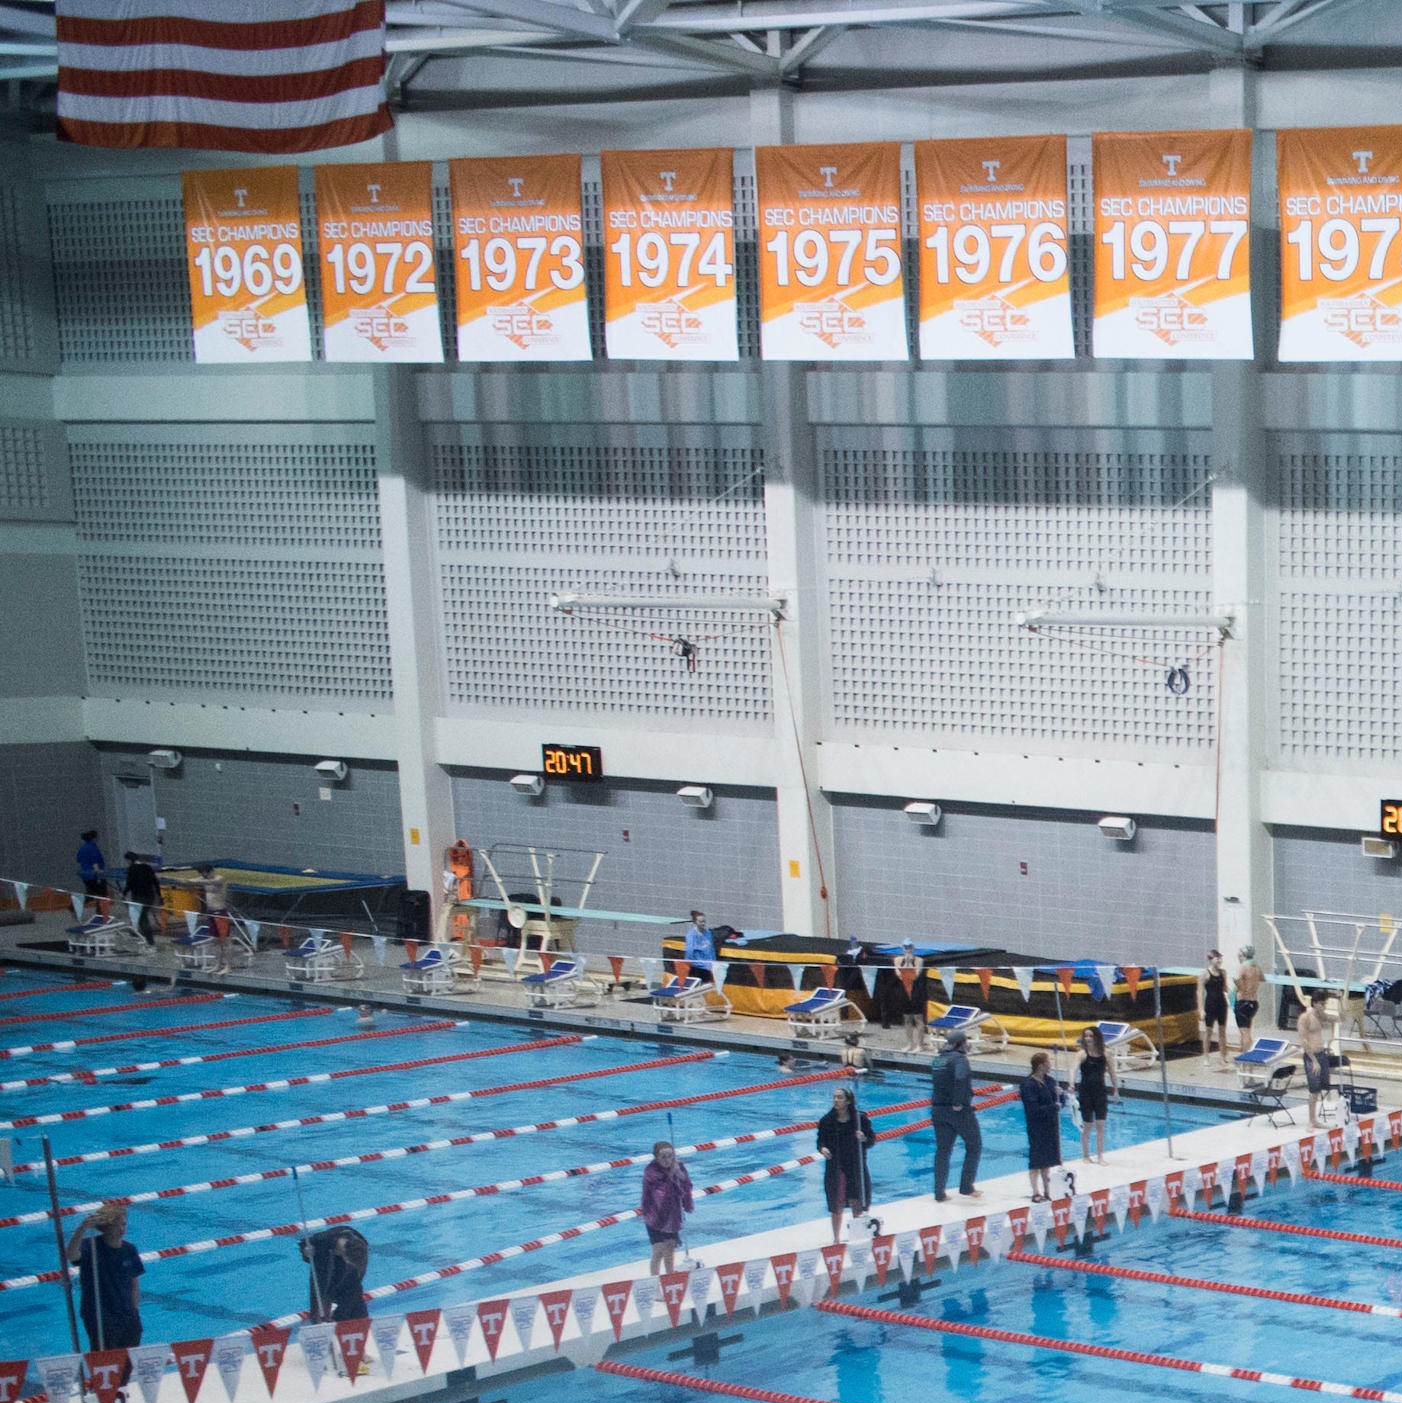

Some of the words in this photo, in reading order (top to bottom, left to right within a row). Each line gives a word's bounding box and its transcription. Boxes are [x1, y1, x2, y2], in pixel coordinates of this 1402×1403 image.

[982, 160, 1000, 182] T
[1162, 154, 1181, 176] T
[1352, 150, 1373, 173] T
[508, 178, 524, 197] T
[660, 172, 676, 191] T
[820, 166, 837, 187] T
[234, 188, 248, 207] T
[367, 184, 381, 203] T
[765, 207, 794, 226] SEC
[799, 206, 898, 225] CHAMPIONS
[923, 203, 955, 223] SEC
[960, 200, 1065, 220] CHAMPIONS
[1100, 198, 1133, 217] SEC
[1138, 196, 1247, 216] CHAMPIONS
[1286, 197, 1320, 216] SEC
[324, 222, 347, 239] SEC
[351, 220, 432, 238] CHAMPIONS
[459, 217, 485, 235] SEC
[489, 214, 581, 233] CHAMPIONS
[609, 211, 636, 228] SEC
[640, 210, 732, 228] CHAMPIONS
[191, 226, 214, 242] SEC
[218, 222, 298, 240] CHAMPIONS
[611, 231, 733, 287] 1974
[766, 228, 901, 287] 1975
[925, 222, 1068, 284] 1976
[1101, 219, 1249, 281] 1977
[194, 242, 302, 297] 1969
[327, 241, 435, 294] 1972
[460, 235, 585, 291] 1973
[225, 317, 276, 338] SEC
[356, 317, 408, 338] SEC
[494, 315, 553, 335] SEC
[643, 313, 702, 333] SEC
[802, 312, 866, 333] SEC
[962, 310, 1030, 332] SEC
[1136, 308, 1208, 331] SEC
[1325, 308, 1402, 331] SEC
[545, 750, 593, 775] 20:47
[413, 1322, 435, 1346] T
[482, 1312, 504, 1335] T
[342, 1333, 364, 1356] T
[181, 1354, 205, 1378] T
[259, 1344, 282, 1368] T
[93, 1364, 119, 1390] T
